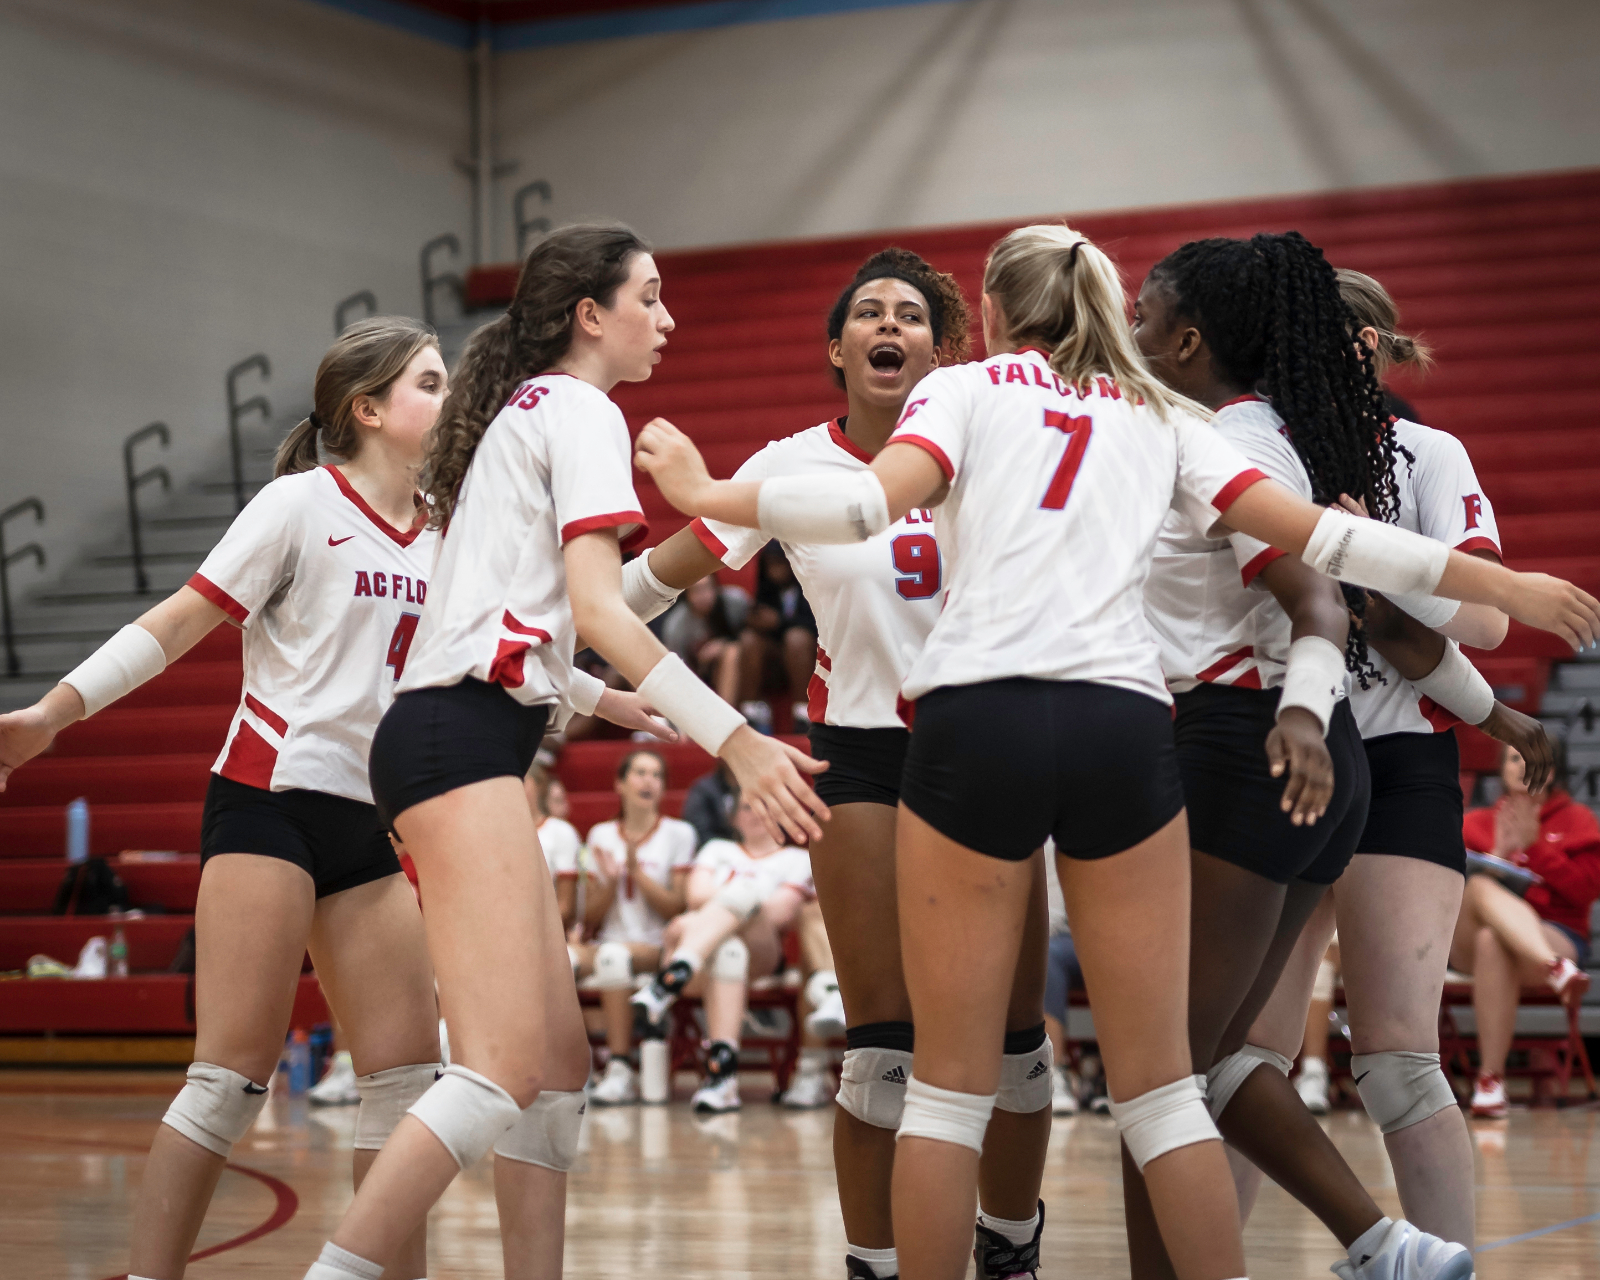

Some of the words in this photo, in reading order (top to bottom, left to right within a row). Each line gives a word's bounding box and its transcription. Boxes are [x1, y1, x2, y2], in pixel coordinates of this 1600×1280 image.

[986, 362, 1146, 406] FALCON
[1038, 407, 1093, 511] 7
[1461, 493, 1482, 533] F
[354, 570, 388, 598] AC
[391, 573, 429, 606] FLO
[889, 532, 942, 601] 9
[386, 611, 421, 682] 4
